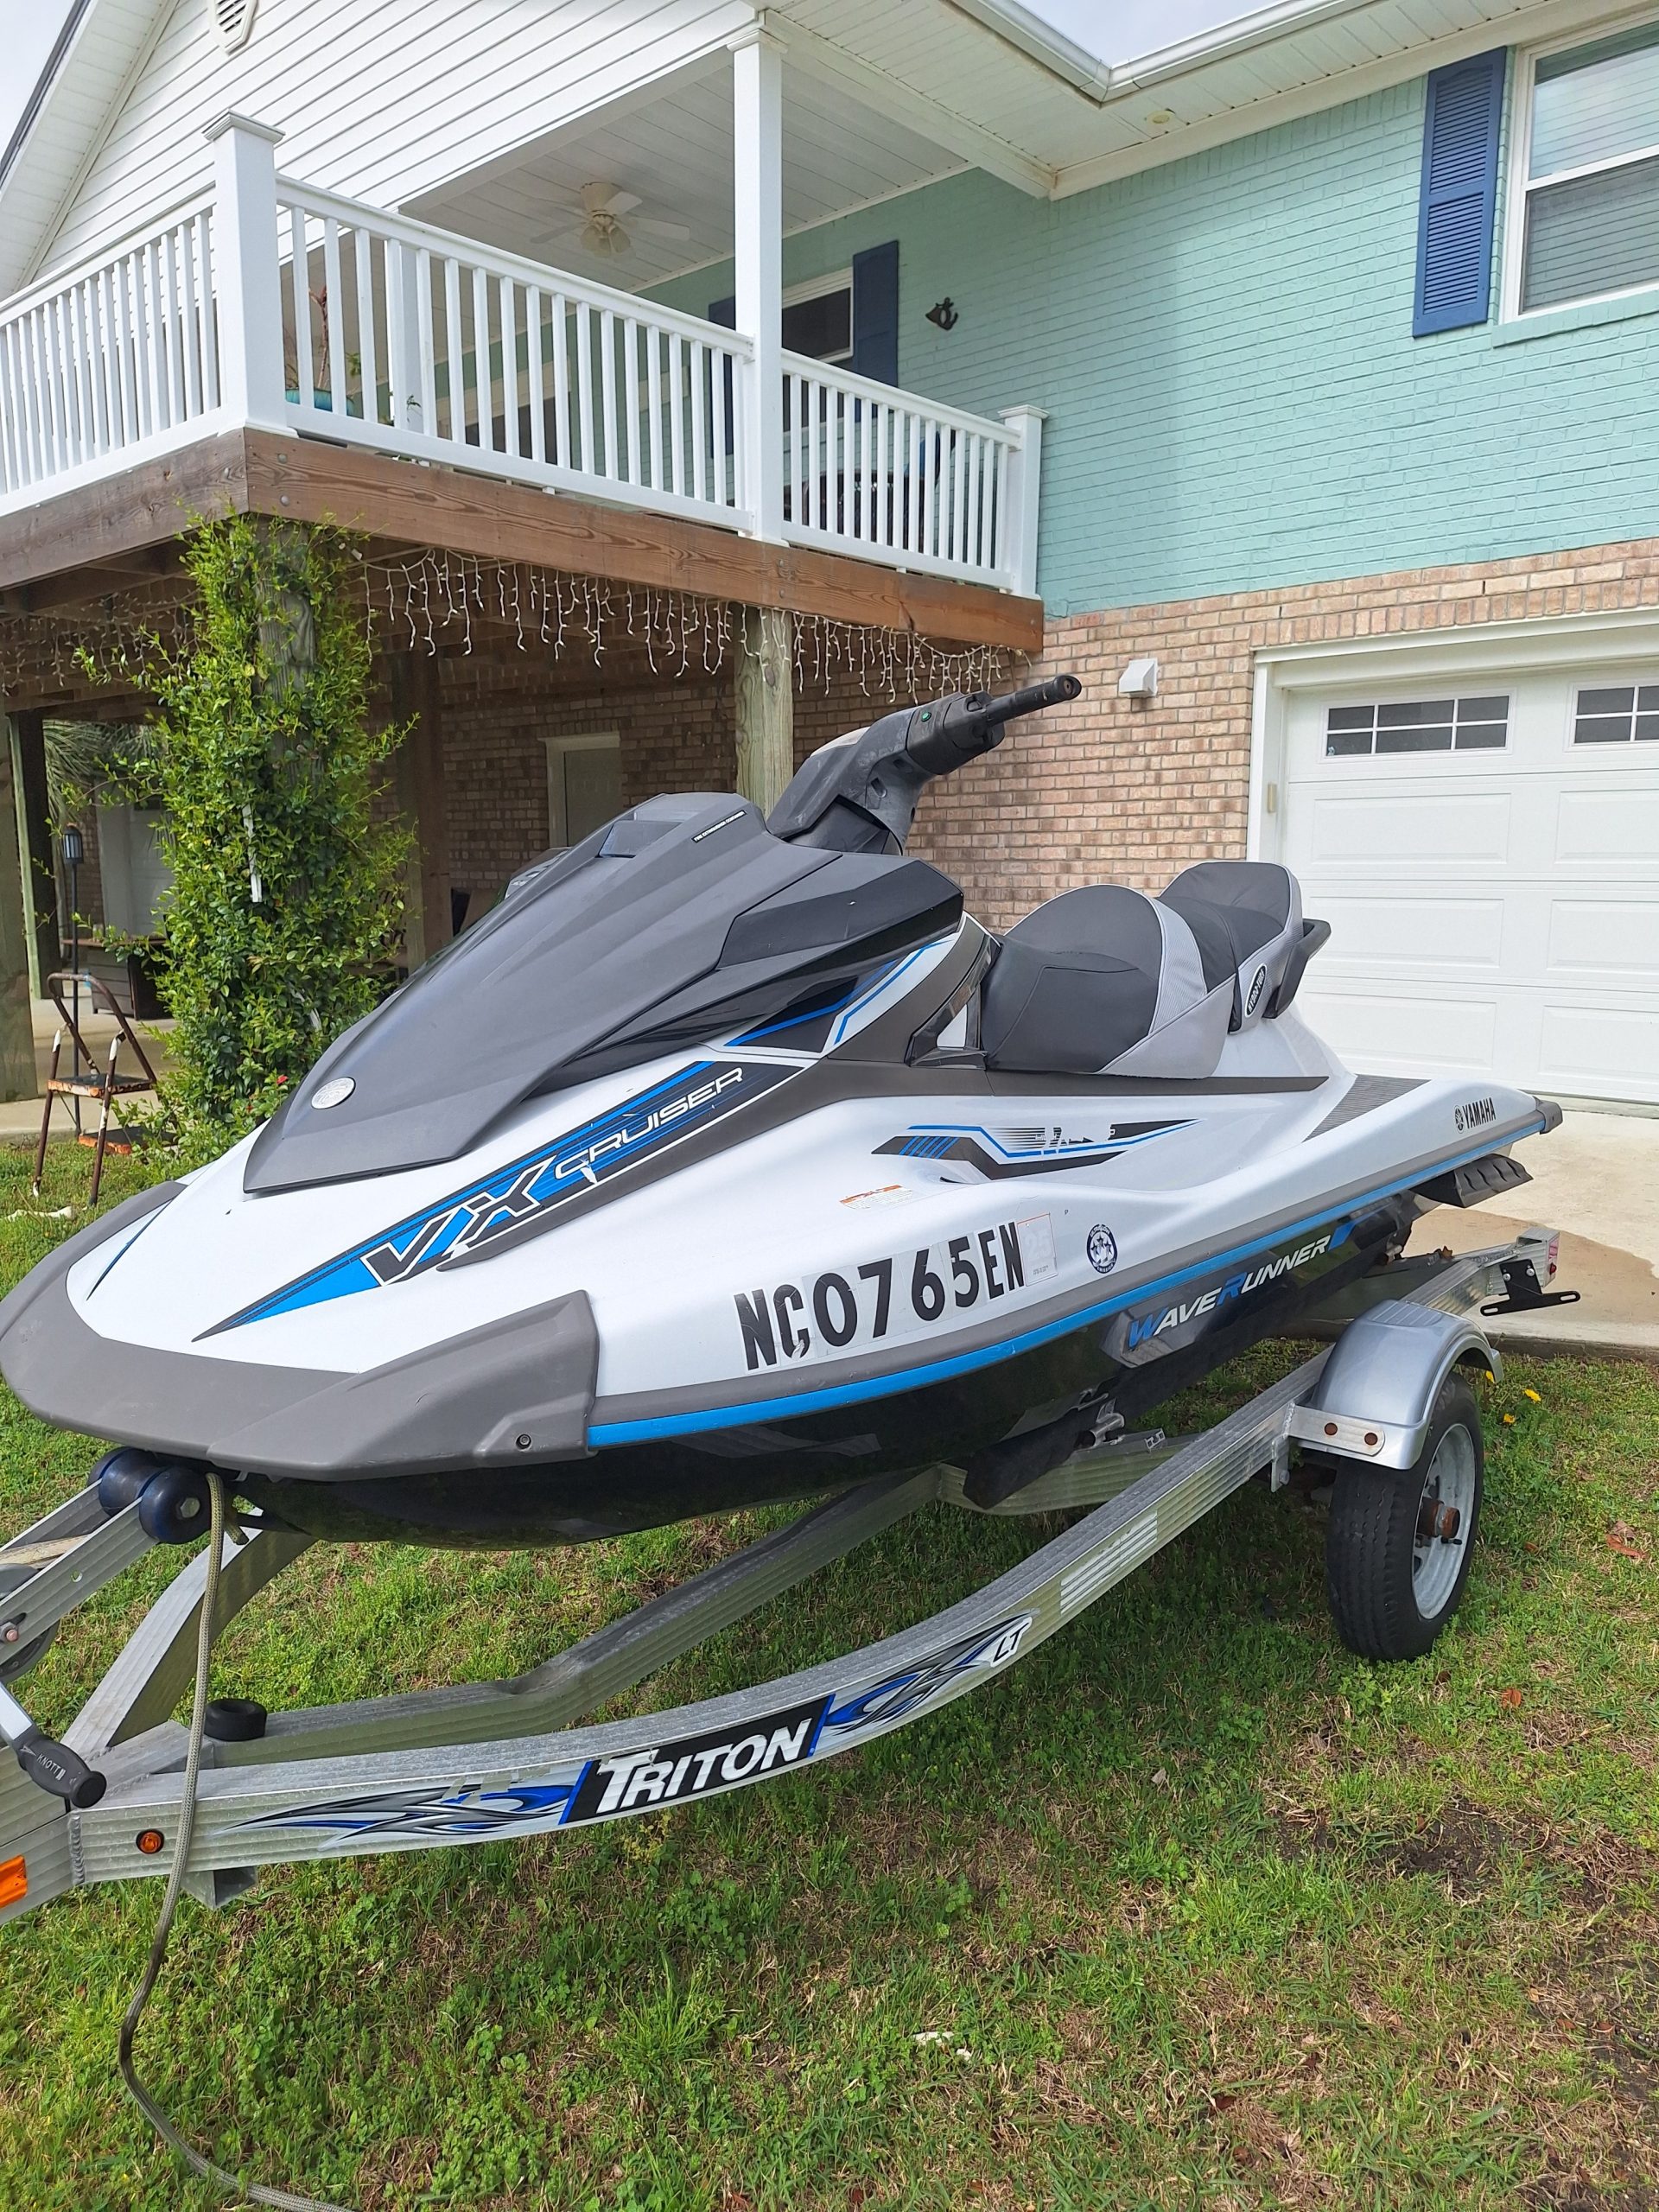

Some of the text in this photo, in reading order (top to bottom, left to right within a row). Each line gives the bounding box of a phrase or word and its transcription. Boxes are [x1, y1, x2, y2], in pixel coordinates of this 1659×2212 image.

[555, 1067, 743, 1179] CRUISER
[1462, 1097, 1496, 1129] YAMAHA
[359, 1154, 556, 1287] VX
[993, 1622, 1029, 1662] LT
[37, 1753, 61, 1775] KNOTT
[596, 1718, 812, 1814] TRITON
